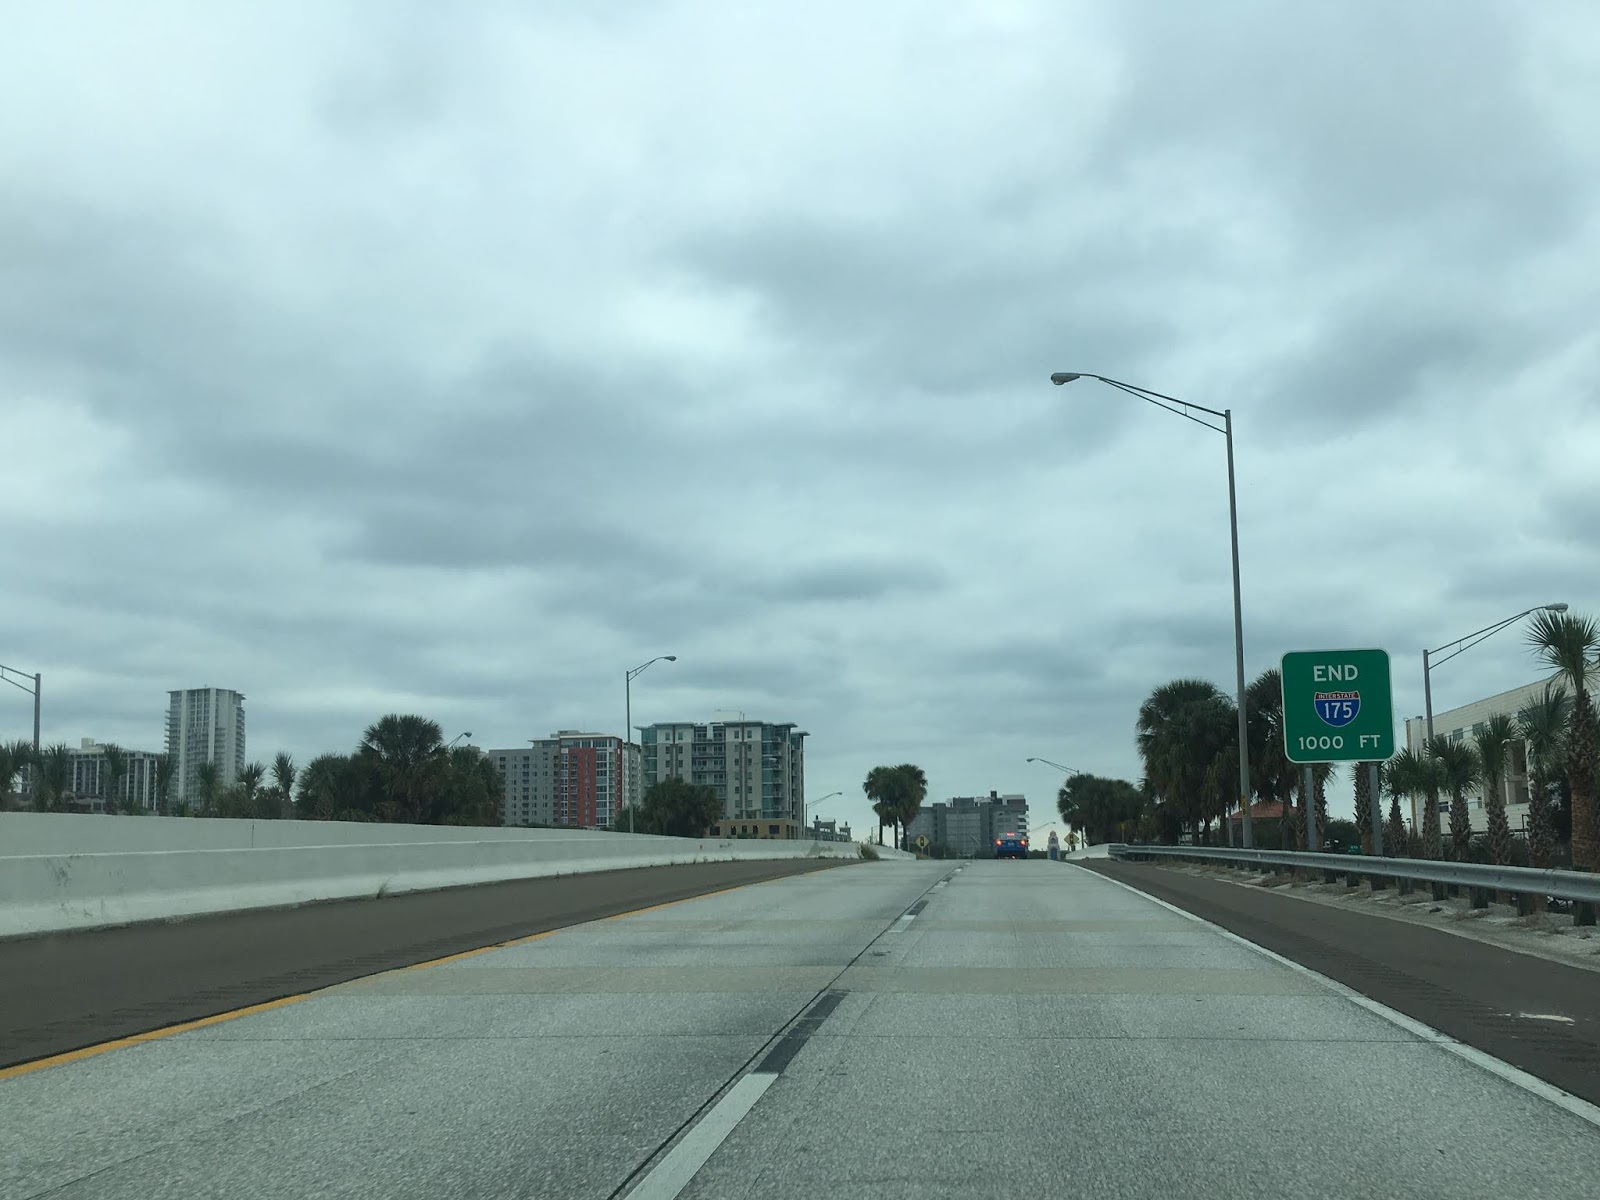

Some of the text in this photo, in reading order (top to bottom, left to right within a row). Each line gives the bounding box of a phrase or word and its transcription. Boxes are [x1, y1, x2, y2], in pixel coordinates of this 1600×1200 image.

[1313, 664, 1358, 682] END
[1324, 702, 1352, 719] 175
[1298, 734, 1381, 750] 1000 FT
